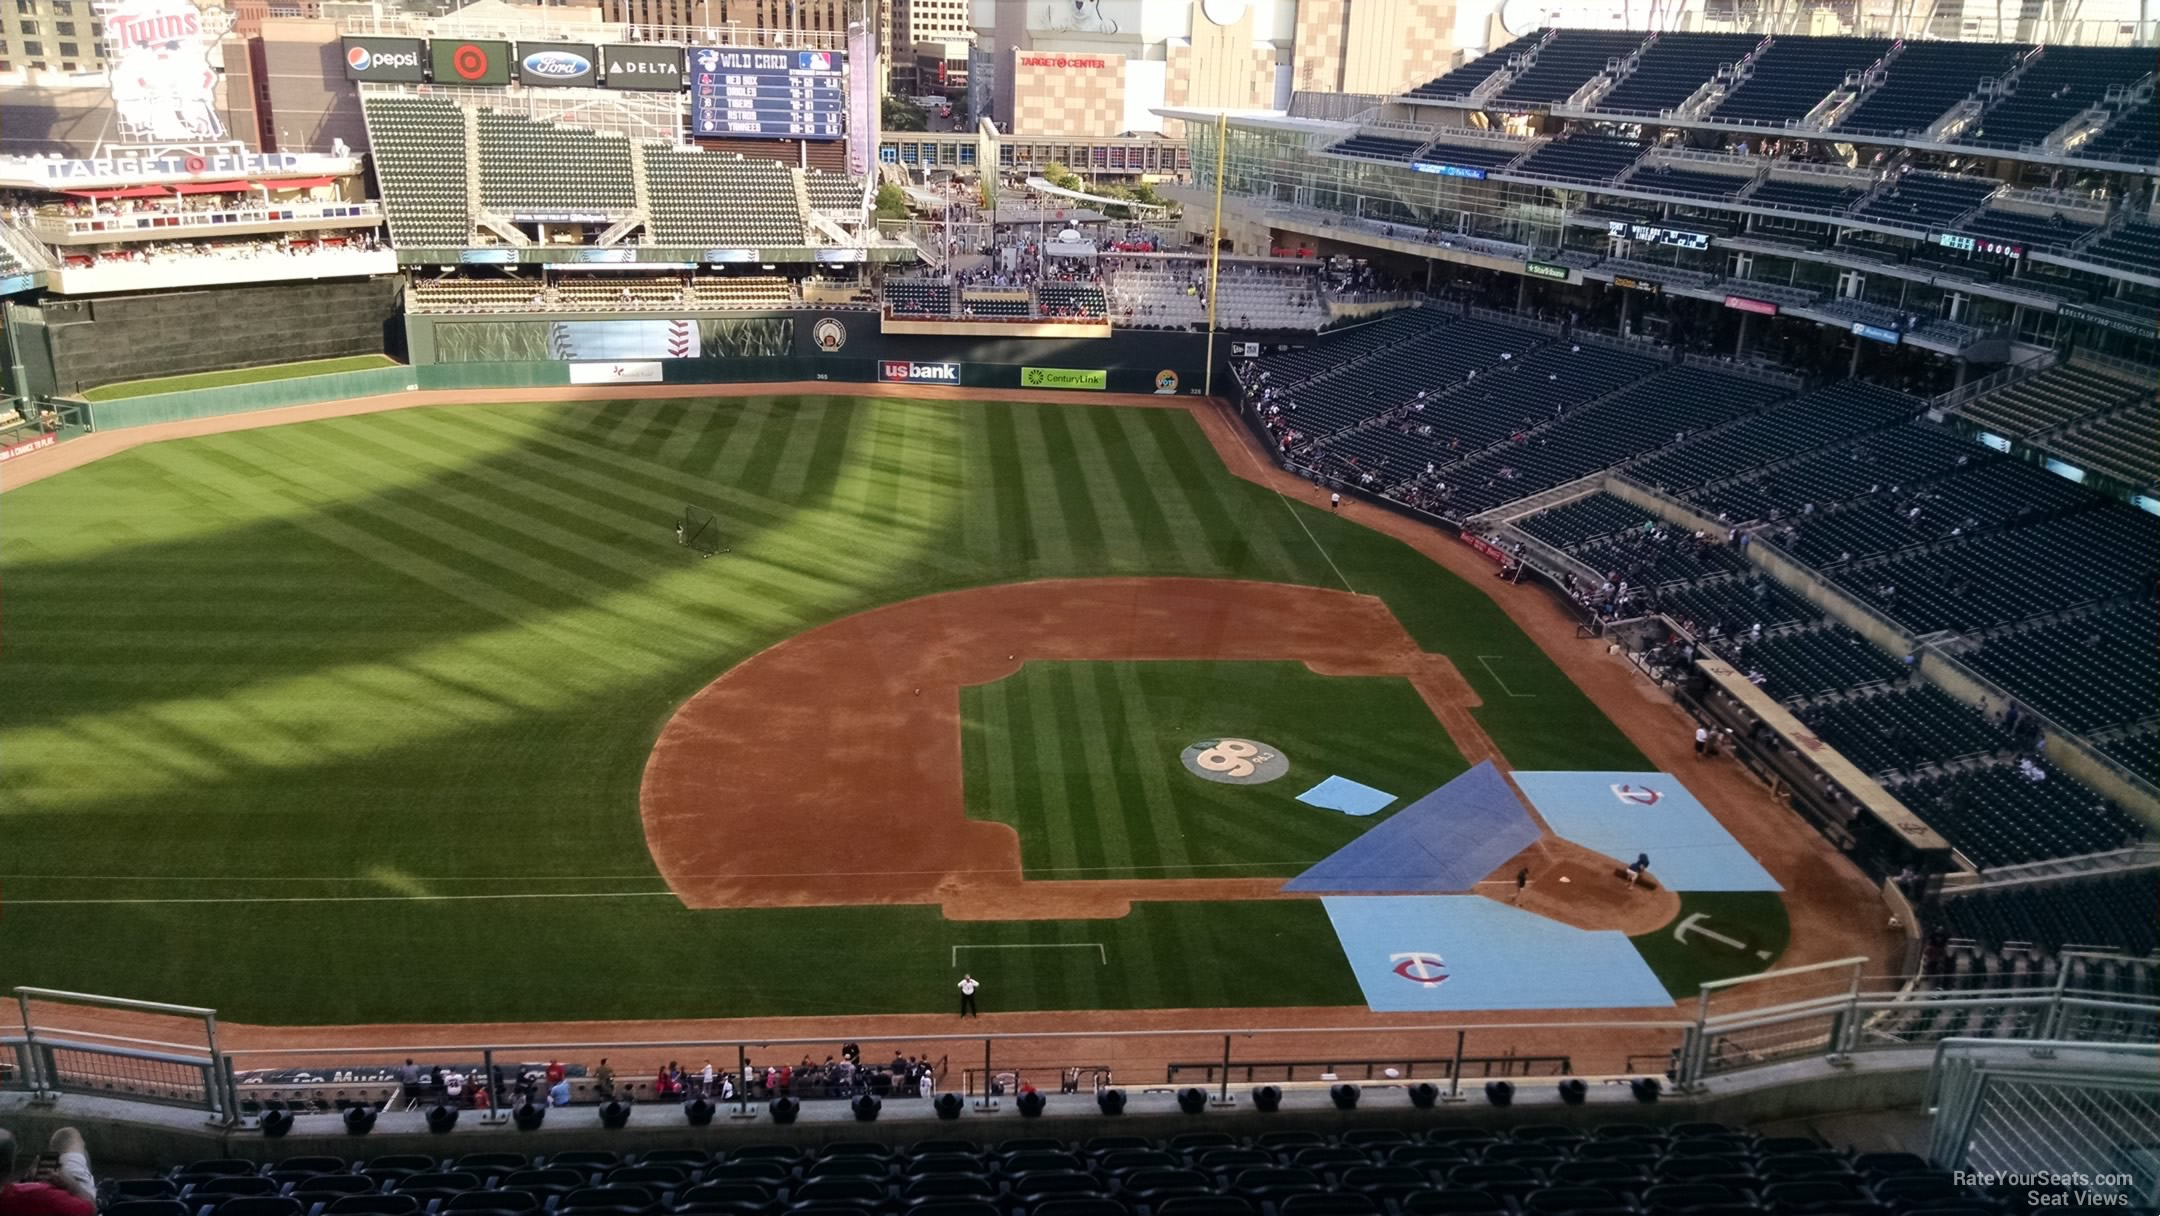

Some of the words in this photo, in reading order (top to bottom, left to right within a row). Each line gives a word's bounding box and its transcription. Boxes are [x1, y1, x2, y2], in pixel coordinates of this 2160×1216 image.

[109, 10, 198, 50] Twins
[373, 52, 418, 68] pepsi
[537, 56, 577, 74] Ford
[720, 53, 751, 68] WILD
[755, 54, 788, 69] CARD
[1020, 57, 1056, 67] TARGET
[1068, 59, 1105, 69] CENTER
[626, 62, 678, 74] DELTA
[726, 76, 741, 84] RED
[743, 76, 758, 85] SOX
[726, 87, 757, 97] ORIOLES
[727, 99, 754, 109] TIGERS
[727, 111, 757, 120] ASTROS
[727, 123, 761, 132] YANKEES
[47, 157, 181, 178] TARGET
[214, 153, 298, 173] FIELD
[2065, 309, 2085, 319] DELTA
[1046, 374, 1099, 384] CenturyLink
